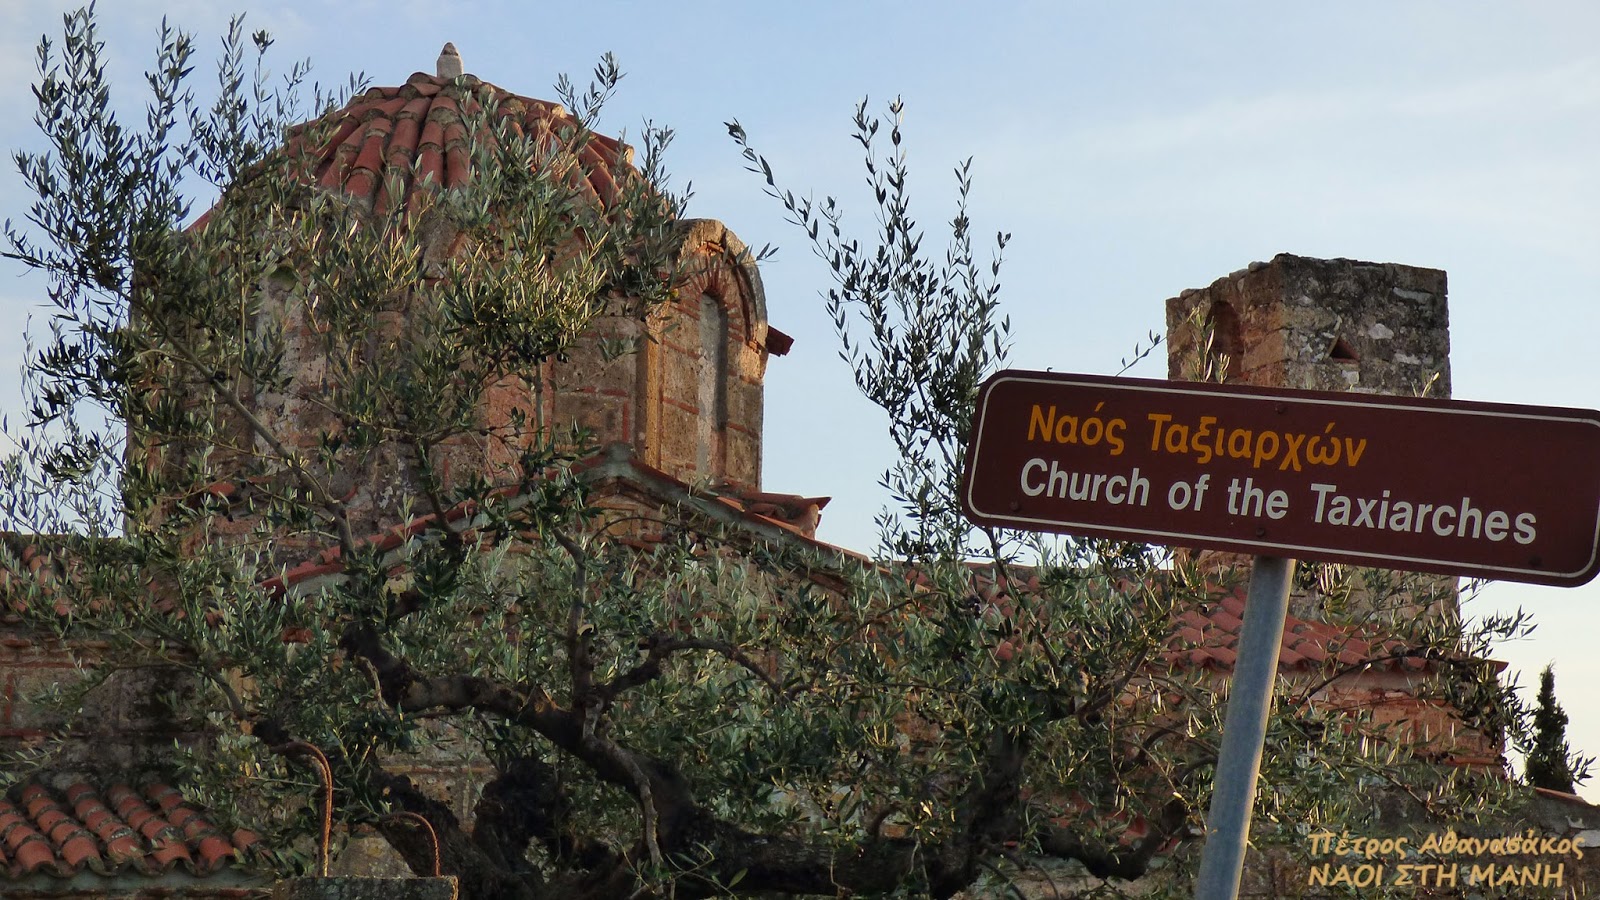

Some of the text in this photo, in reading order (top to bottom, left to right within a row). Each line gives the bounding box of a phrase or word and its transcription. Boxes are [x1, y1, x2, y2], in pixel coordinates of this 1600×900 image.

[1027, 401, 1367, 472] Ναός Ταξιαρχών
[1021, 458, 1537, 545] Church of the Taxiarches
